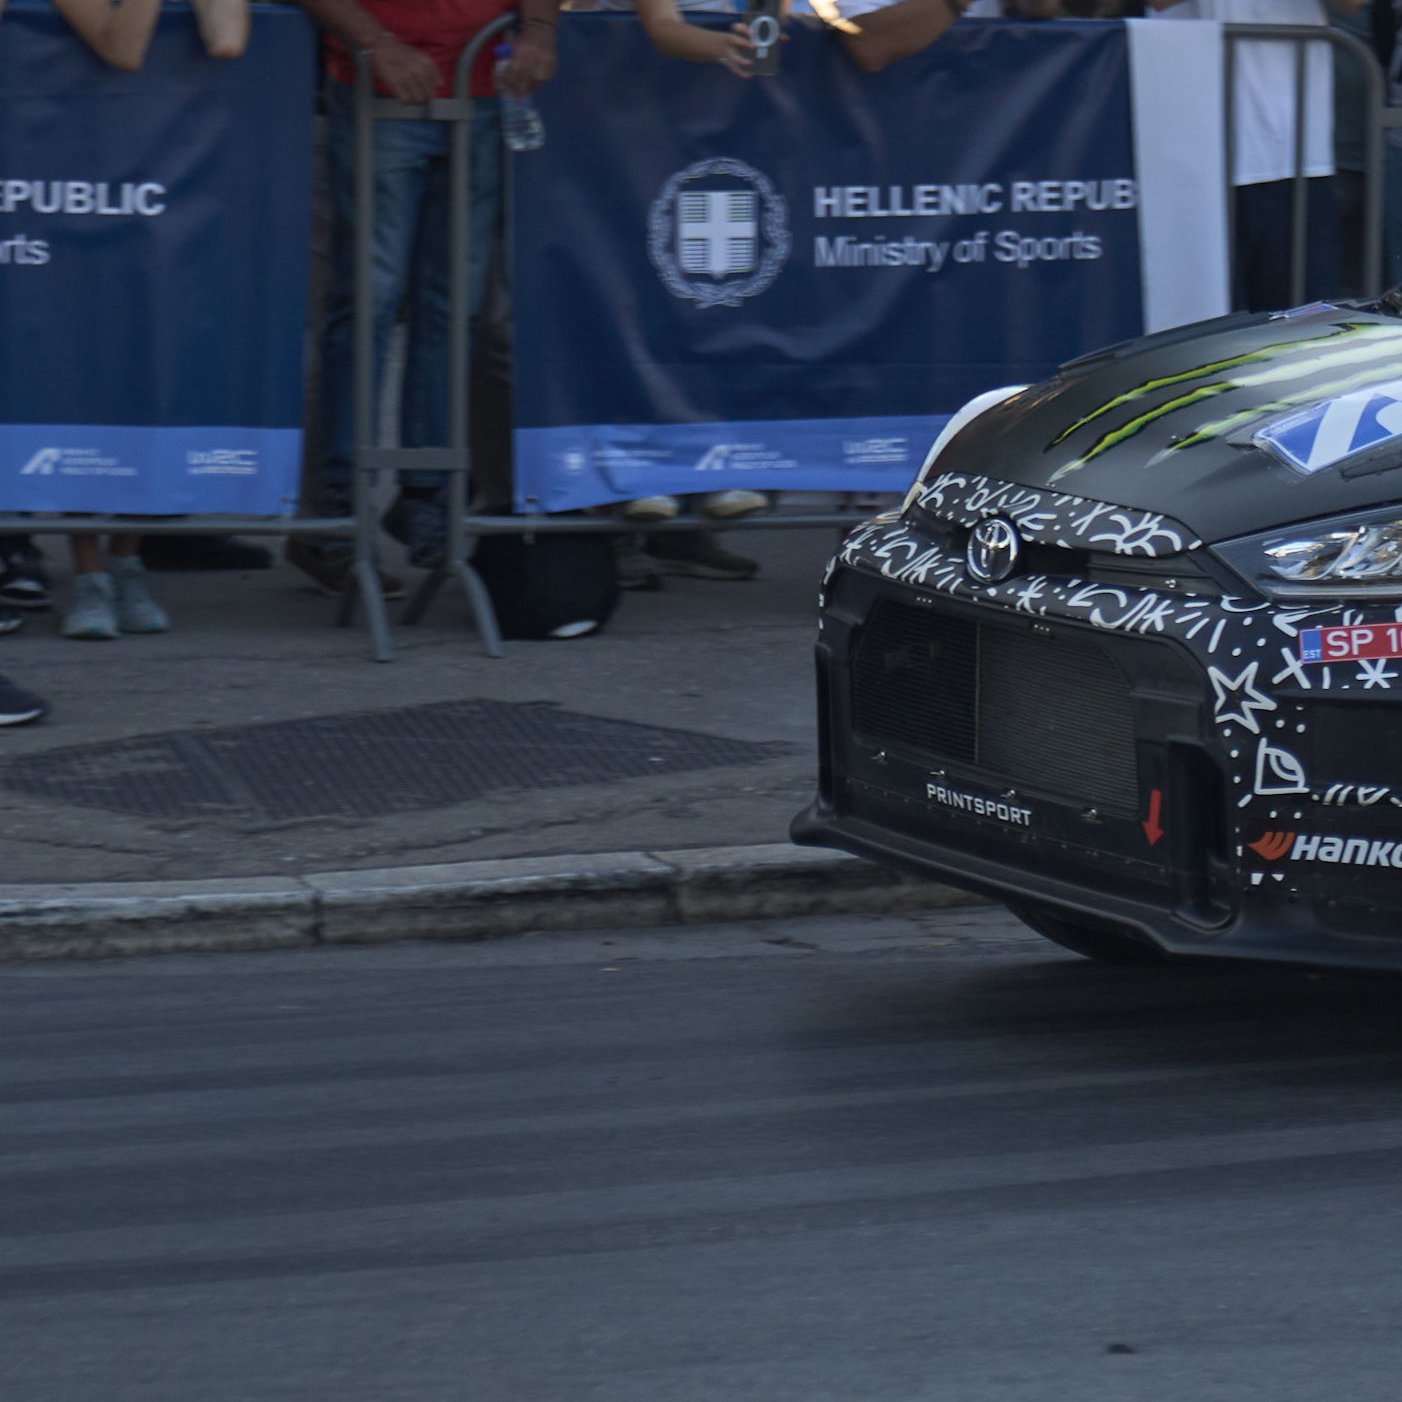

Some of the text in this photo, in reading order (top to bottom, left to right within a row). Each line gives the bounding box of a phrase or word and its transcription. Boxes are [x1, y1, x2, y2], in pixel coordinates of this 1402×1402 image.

[0, 179, 167, 216] PUBLIC
[814, 184, 1003, 218] HELLENIC
[814, 230, 1102, 273] Ministry of Sports
[1303, 649, 1321, 660] EST
[1327, 629, 1374, 656] SP
[926, 783, 1032, 826] PRINTSPORT
